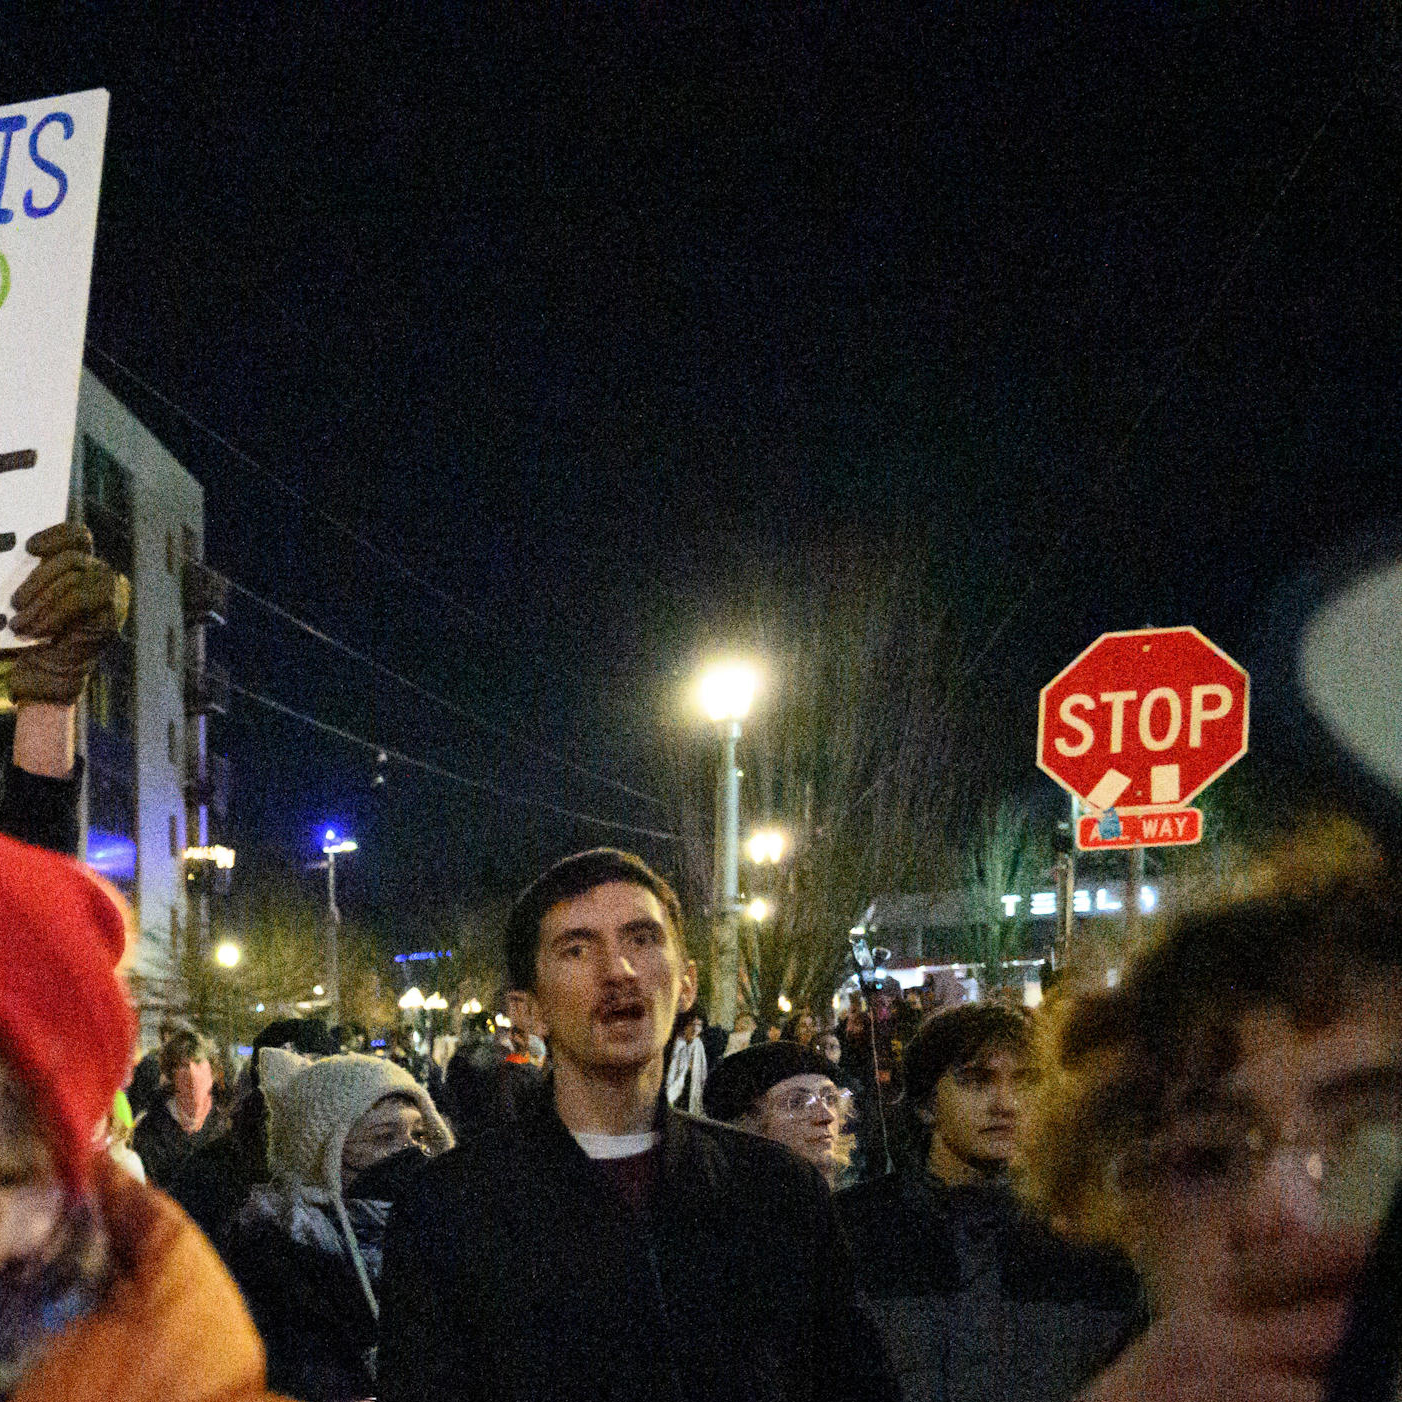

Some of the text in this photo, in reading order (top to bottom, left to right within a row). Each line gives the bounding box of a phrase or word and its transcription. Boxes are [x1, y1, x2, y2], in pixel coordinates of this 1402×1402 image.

[1054, 684, 1233, 757] STOP
[1089, 816, 1189, 842] AL WAY
